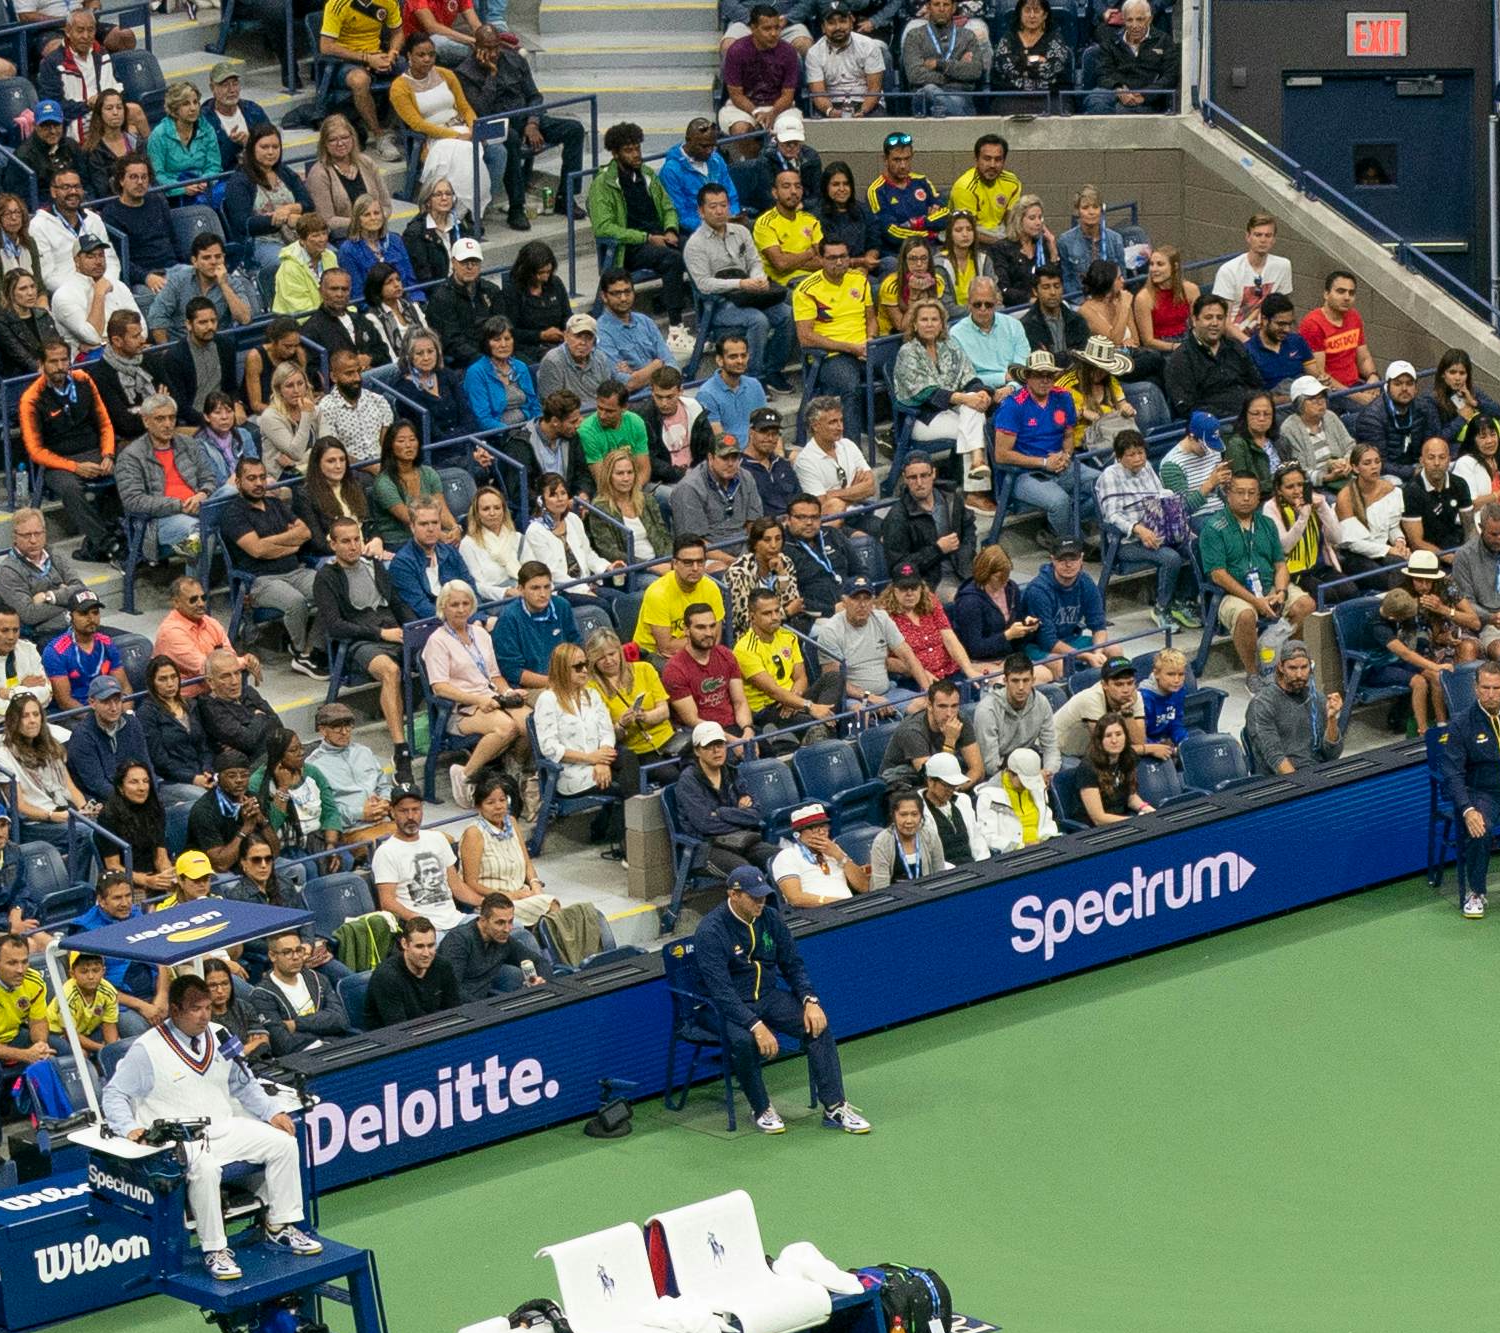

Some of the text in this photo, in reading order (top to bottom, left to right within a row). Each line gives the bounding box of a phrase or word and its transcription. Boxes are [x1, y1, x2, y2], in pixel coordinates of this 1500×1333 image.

[1355, 20, 1402, 56] EXIT
[1010, 850, 1241, 961] Spectrum
[305, 1054, 559, 1168] Deloitte.
[88, 1164, 155, 1206] Spectrum
[34, 1234, 151, 1283] Wilson
